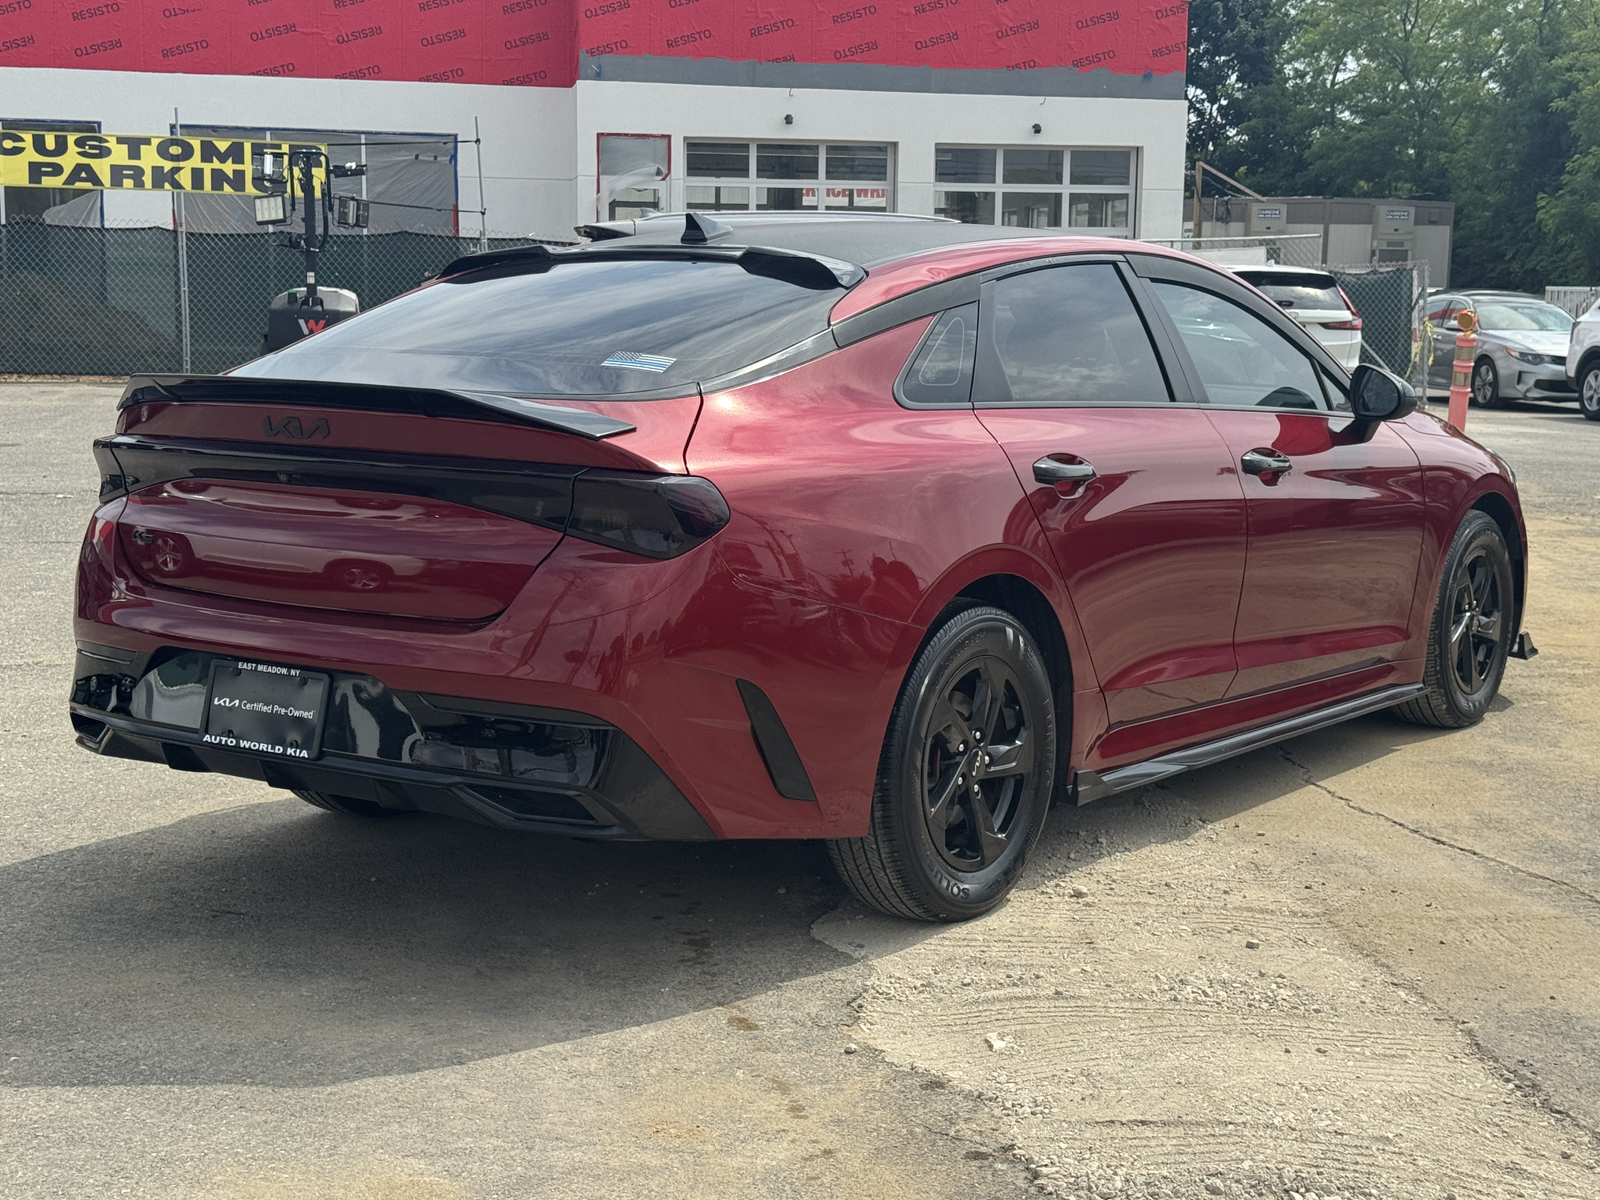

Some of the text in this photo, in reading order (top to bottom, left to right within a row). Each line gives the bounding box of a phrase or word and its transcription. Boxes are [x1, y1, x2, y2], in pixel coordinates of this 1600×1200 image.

[72, 2, 121, 22] RESISTO
[585, 0, 630, 18] RESISTO
[832, 5, 877, 25] RESISTO
[749, 18, 795, 38] RESISTO
[995, 19, 1040, 40] RESISTO
[1076, 10, 1120, 30] RESISTO
[250, 23, 297, 42] RESISTO
[336, 25, 382, 45] RESISTO
[420, 28, 466, 47] RESISTO
[504, 31, 549, 50] RESISTO
[666, 29, 712, 49] RESISTO
[914, 31, 959, 51] RESISTO
[74, 38, 123, 58] RESISTO
[162, 39, 209, 59] RESISTO
[833, 40, 878, 60] RESISTO
[1072, 50, 1116, 68] RESISTO
[263, 415, 330, 439] KIA
[238, 661, 256, 671] EAST
[290, 669, 301, 677] NY
[213, 697, 313, 719] KIA Certified Pre-Owned
[202, 735, 309, 758] AUTO WORLD KIA
